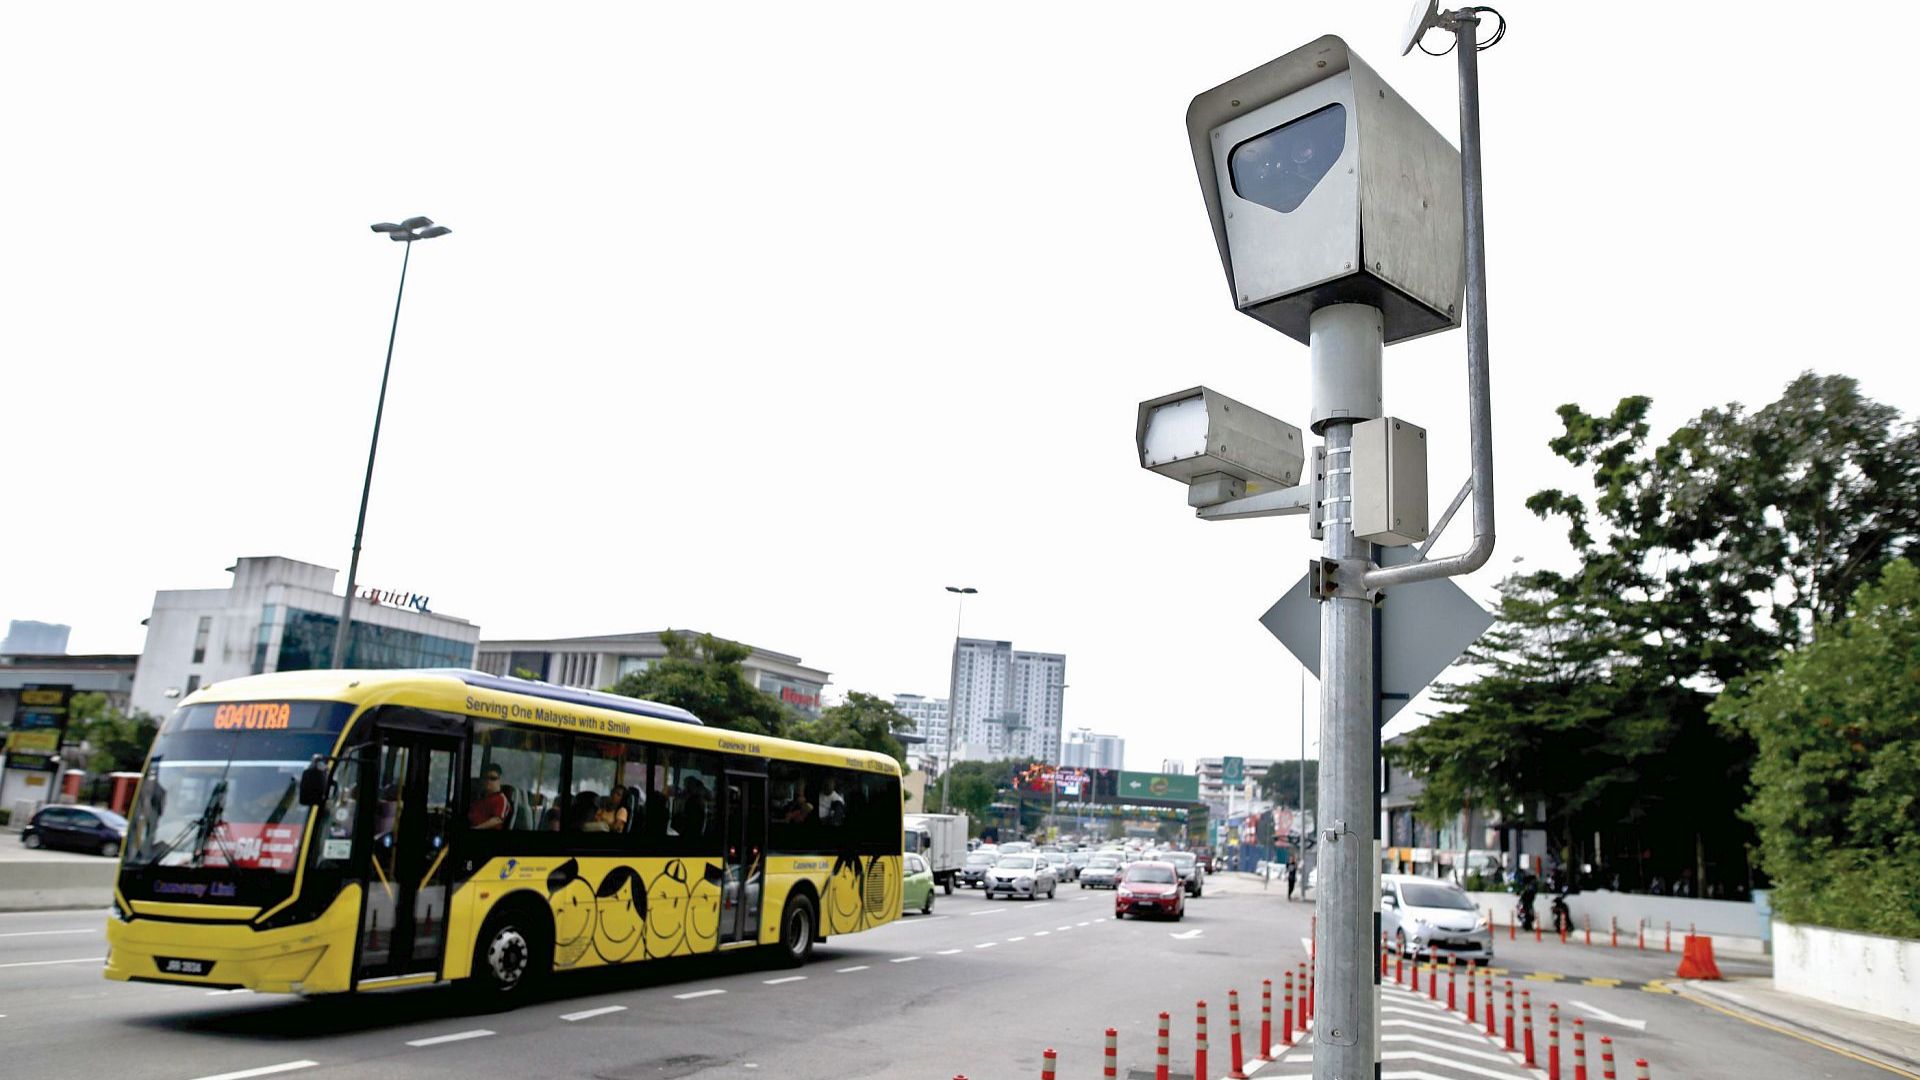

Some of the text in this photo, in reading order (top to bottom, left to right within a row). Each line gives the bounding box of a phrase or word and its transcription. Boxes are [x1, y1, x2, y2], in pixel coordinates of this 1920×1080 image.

[466, 696, 631, 735] Serving One Malaysia with a Smile
[718, 738, 760, 753] Causeway Link
[153, 880, 237, 898] Causeway Link
